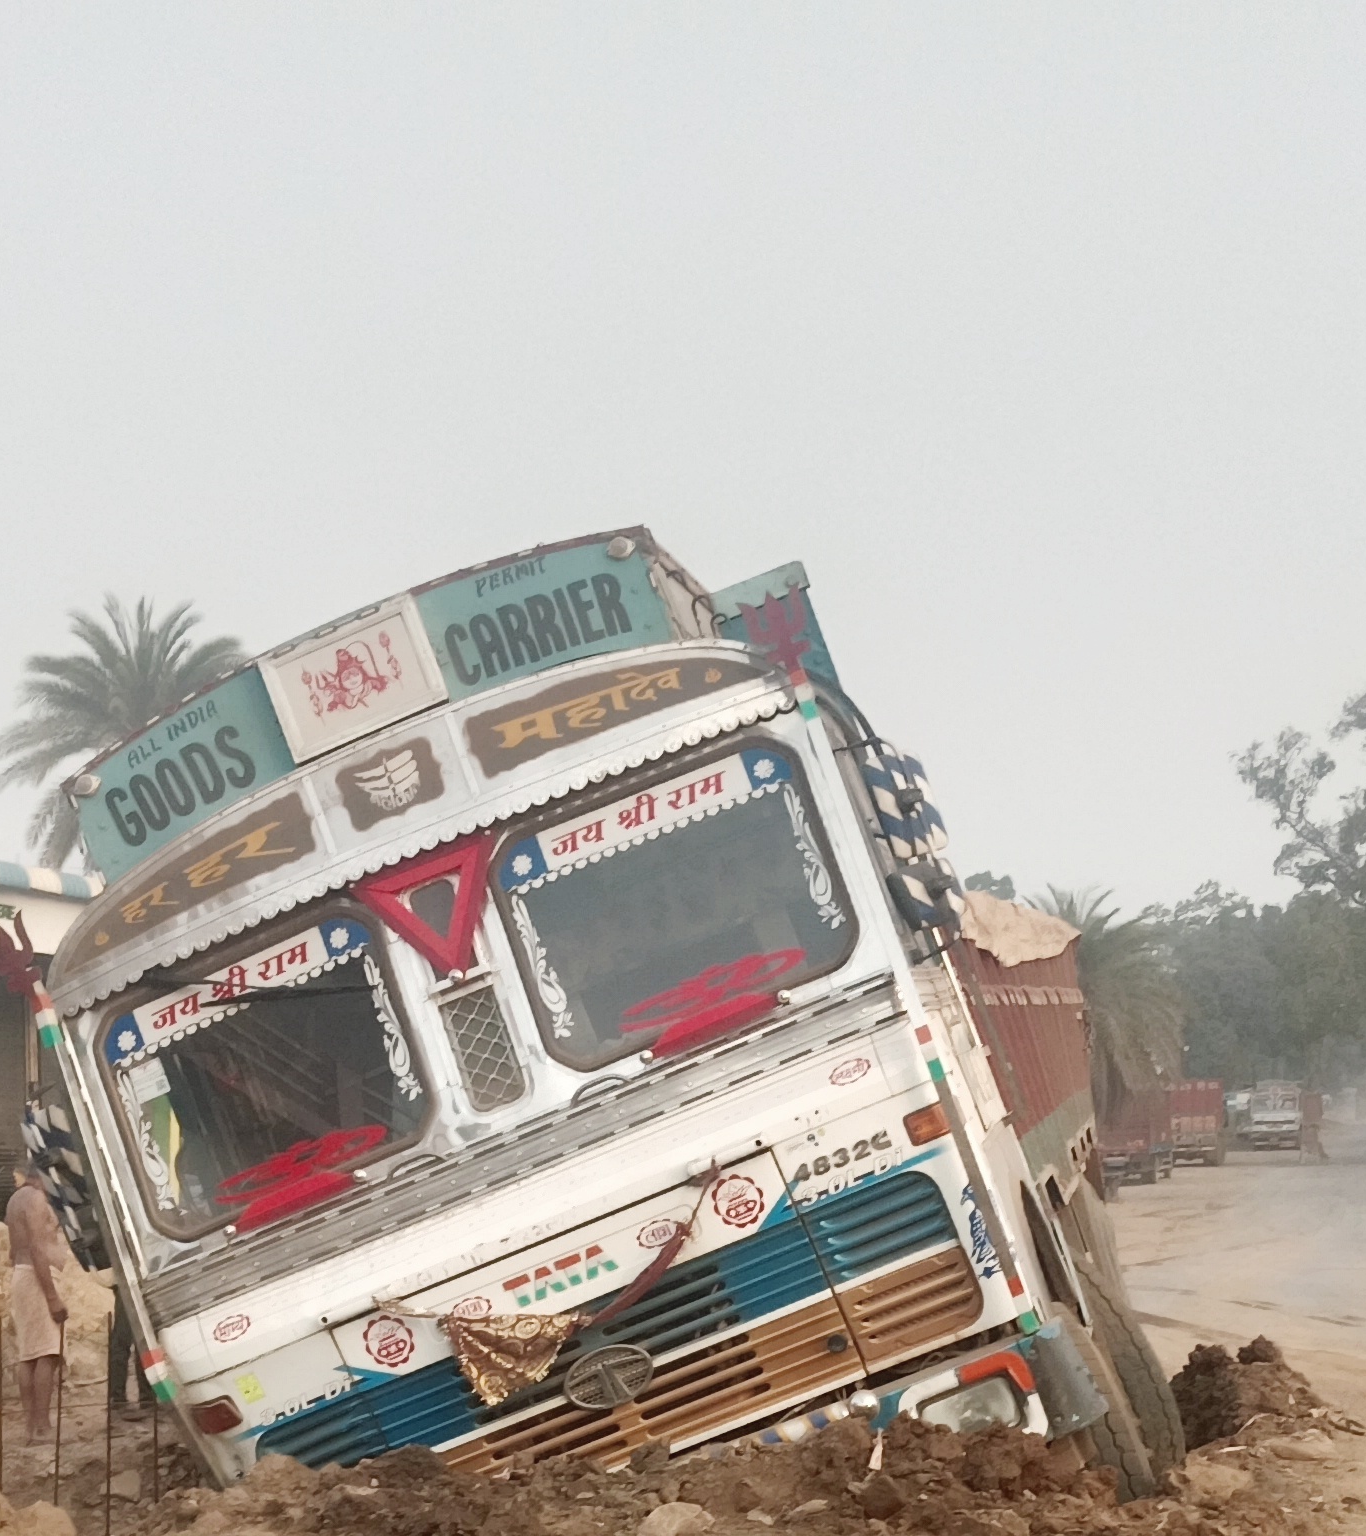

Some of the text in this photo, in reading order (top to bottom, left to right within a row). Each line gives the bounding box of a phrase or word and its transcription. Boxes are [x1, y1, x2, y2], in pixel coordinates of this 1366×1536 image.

[475, 556, 547, 598] PERMIT
[444, 573, 633, 686] CARRIER
[127, 699, 218, 769] ALL INDIA
[491, 667, 683, 748] महादेव
[105, 725, 256, 847] GOODS
[551, 770, 727, 857] जय श्री राम
[151, 991, 202, 1030] जय
[257, 941, 309, 981] राम
[800, 1167, 863, 1207] 3.0L
[502, 1244, 619, 1308] TATA
